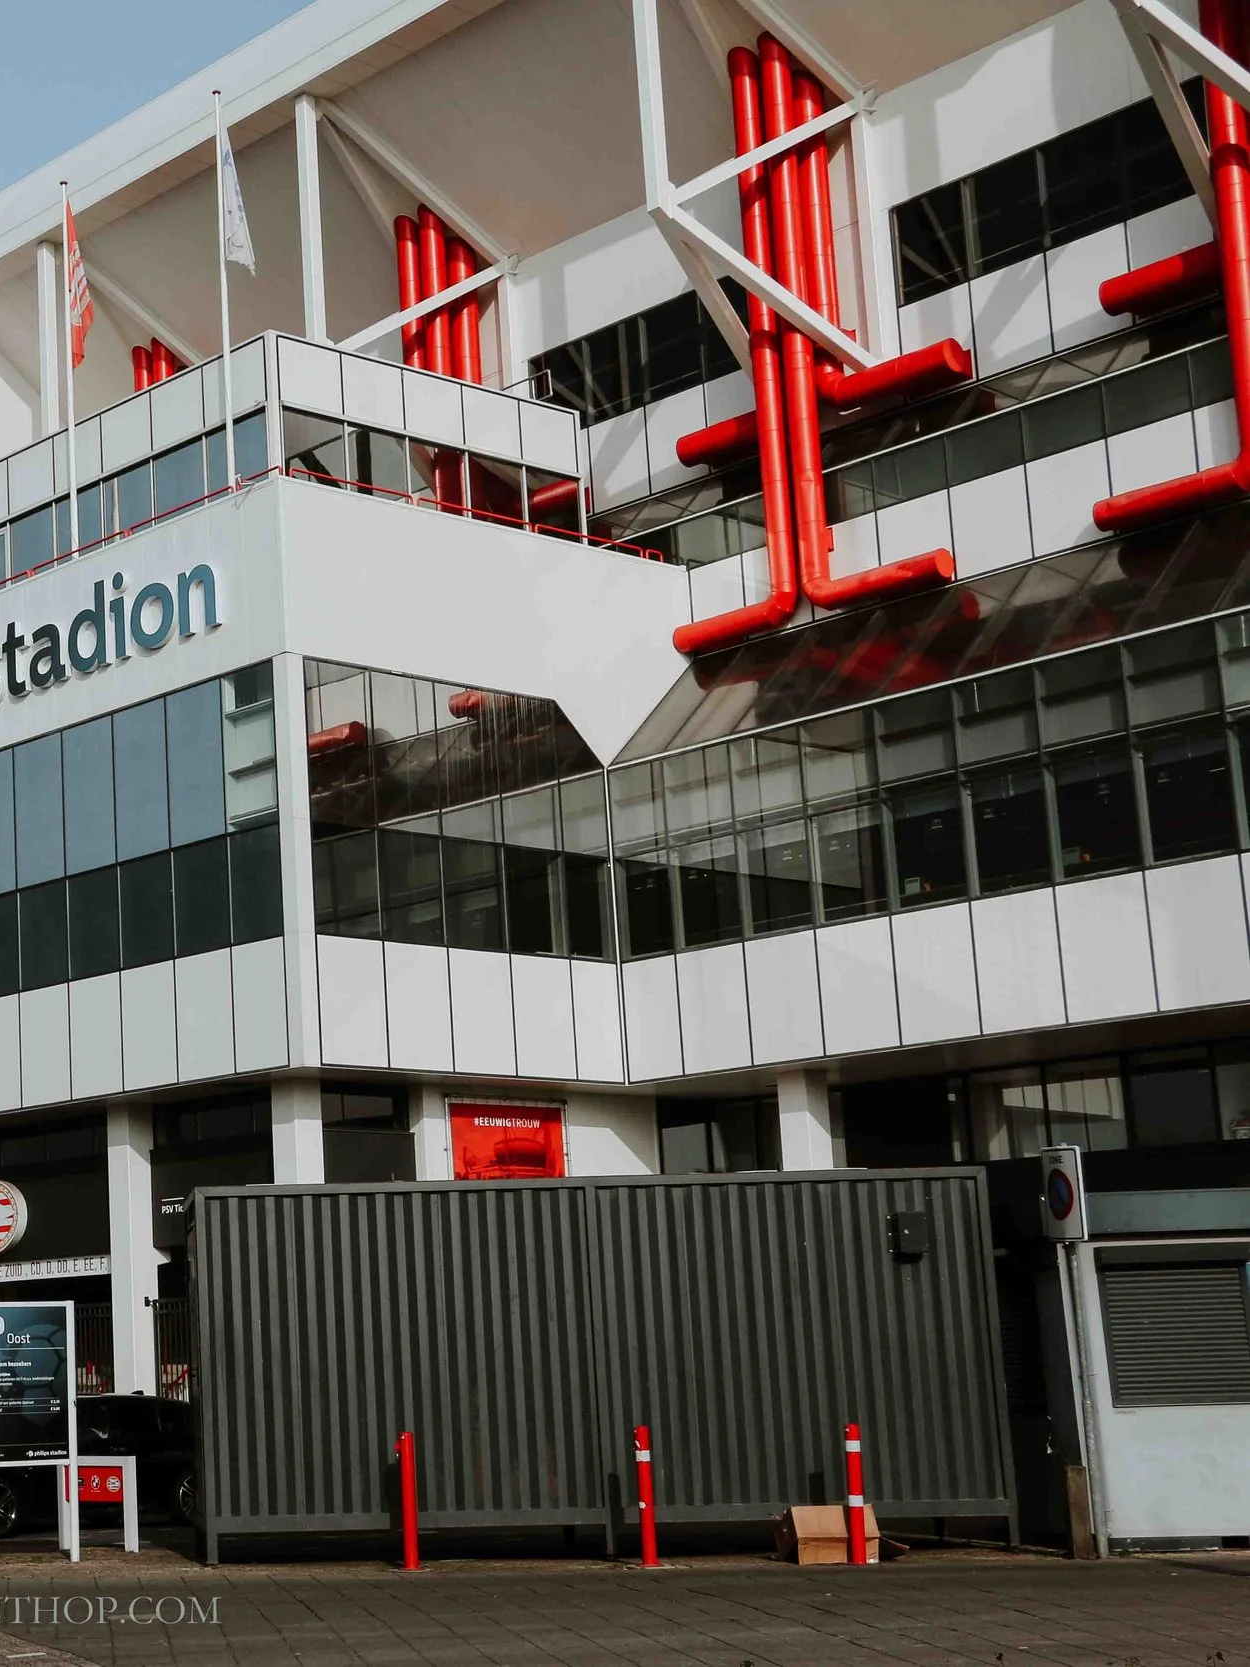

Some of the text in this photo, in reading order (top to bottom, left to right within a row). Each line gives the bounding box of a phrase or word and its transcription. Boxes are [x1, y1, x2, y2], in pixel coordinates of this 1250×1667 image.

[473, 1117, 540, 1129] #EEUWIGTROUW
[161, 1205, 174, 1214] PSV
[7, 1332, 31, 1344] Oost
